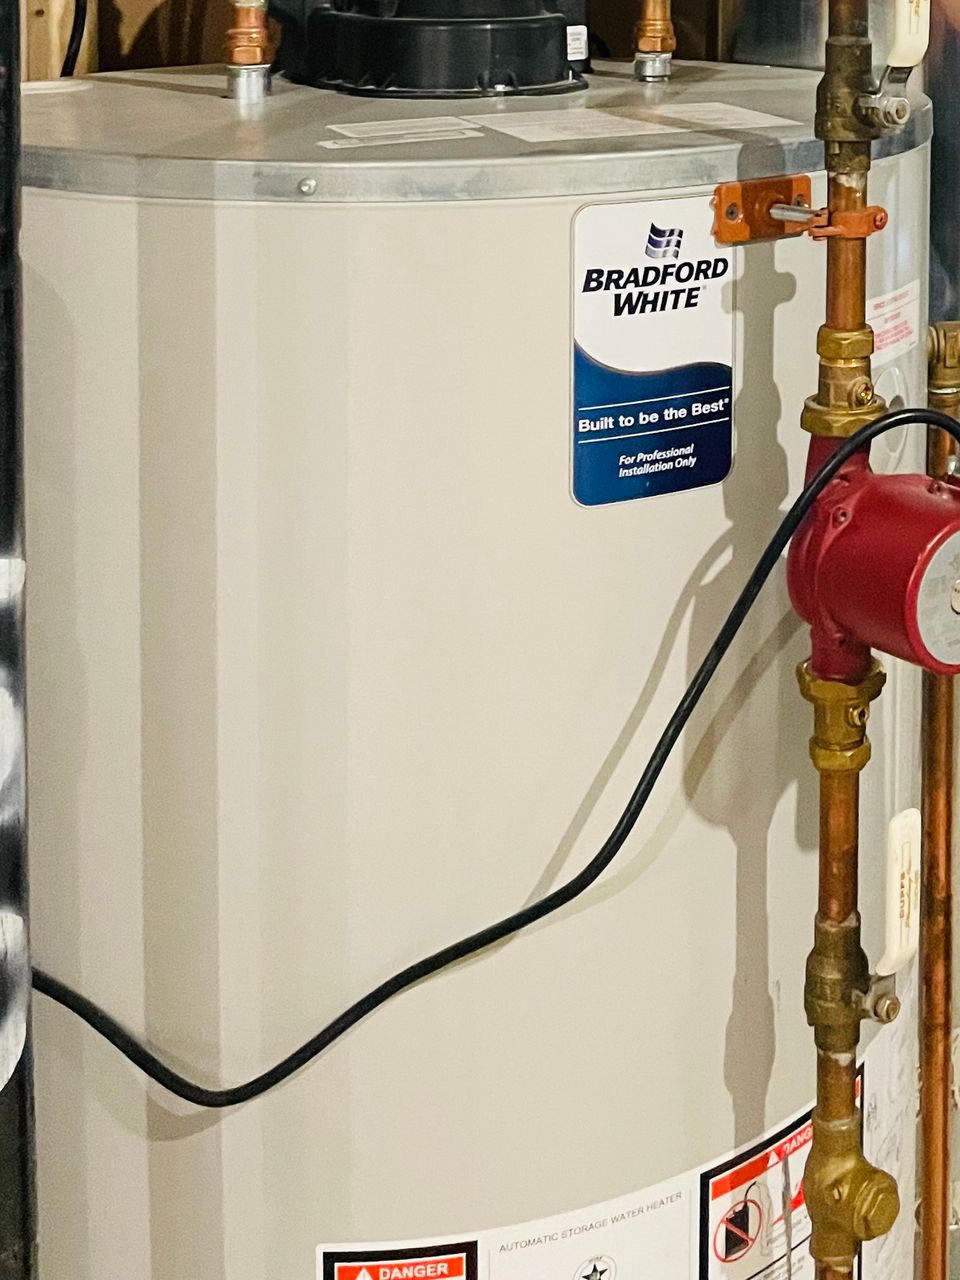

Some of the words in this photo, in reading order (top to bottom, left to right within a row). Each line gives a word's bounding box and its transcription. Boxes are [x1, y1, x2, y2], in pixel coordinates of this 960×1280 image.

[582, 257, 729, 293] BRADFORD
[613, 286, 701, 317] WHITE
[578, 413, 614, 432] Built
[618, 412, 633, 428] to
[639, 410, 659, 426] be
[663, 405, 687, 420] the
[618, 459, 674, 478] Installation
[675, 455, 697, 471] Only
[619, 451, 636, 466] For
[637, 443, 695, 463] Professional
[782, 1127, 813, 1155] DANG
[499, 1233, 559, 1254] AUTOMATIC
[561, 1218, 609, 1240] STORAGE
[610, 1205, 645, 1224] WATER
[646, 1191, 683, 1213] HEATER
[378, 1262, 449, 1280] DANGER
